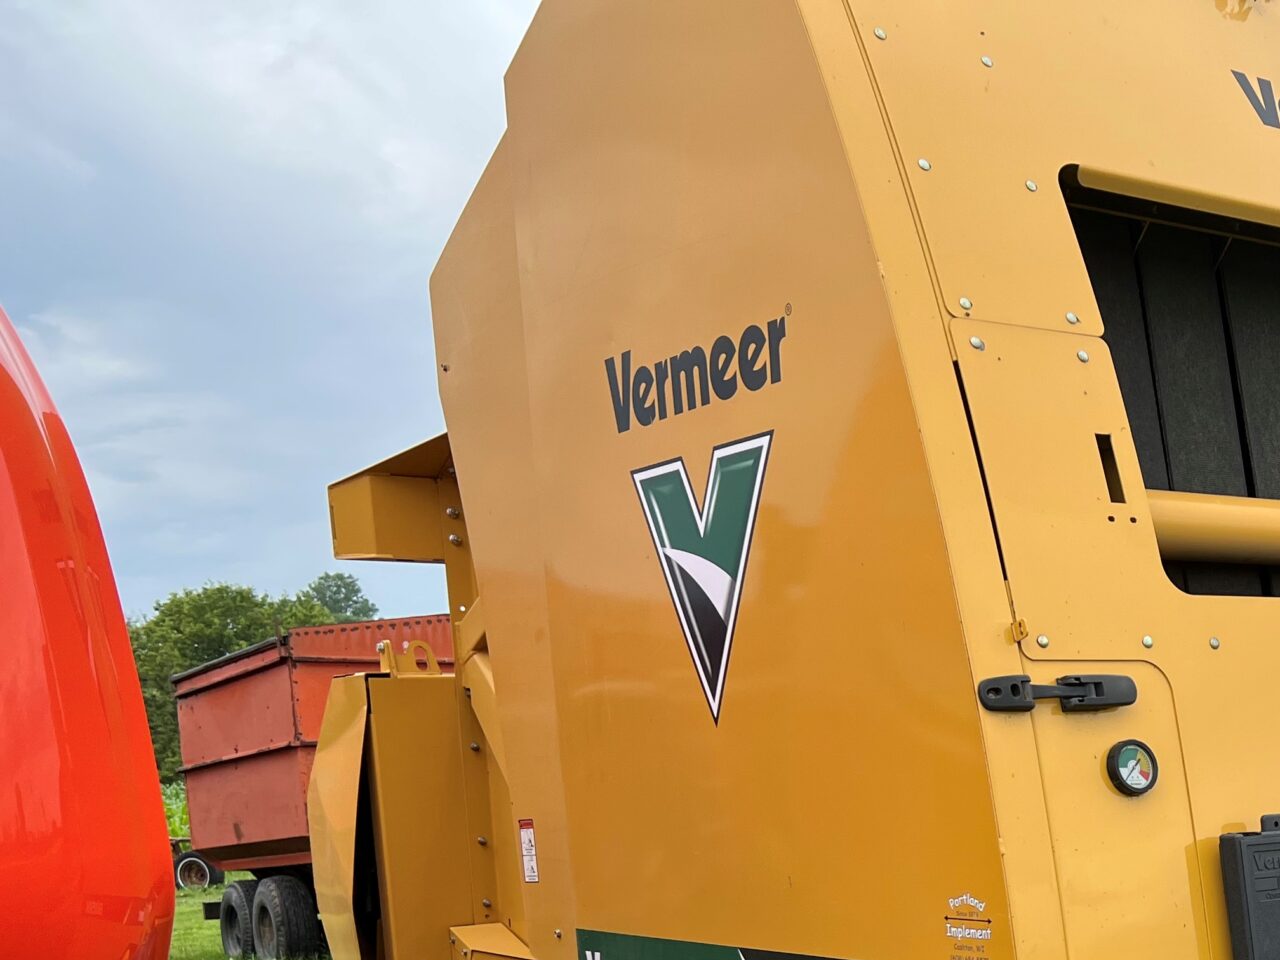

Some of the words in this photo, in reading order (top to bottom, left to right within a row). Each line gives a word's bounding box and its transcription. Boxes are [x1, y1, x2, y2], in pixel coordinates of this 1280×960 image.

[605, 316, 788, 434] Vermeer
[948, 893, 986, 912] Portland
[945, 923, 992, 940] Implement
